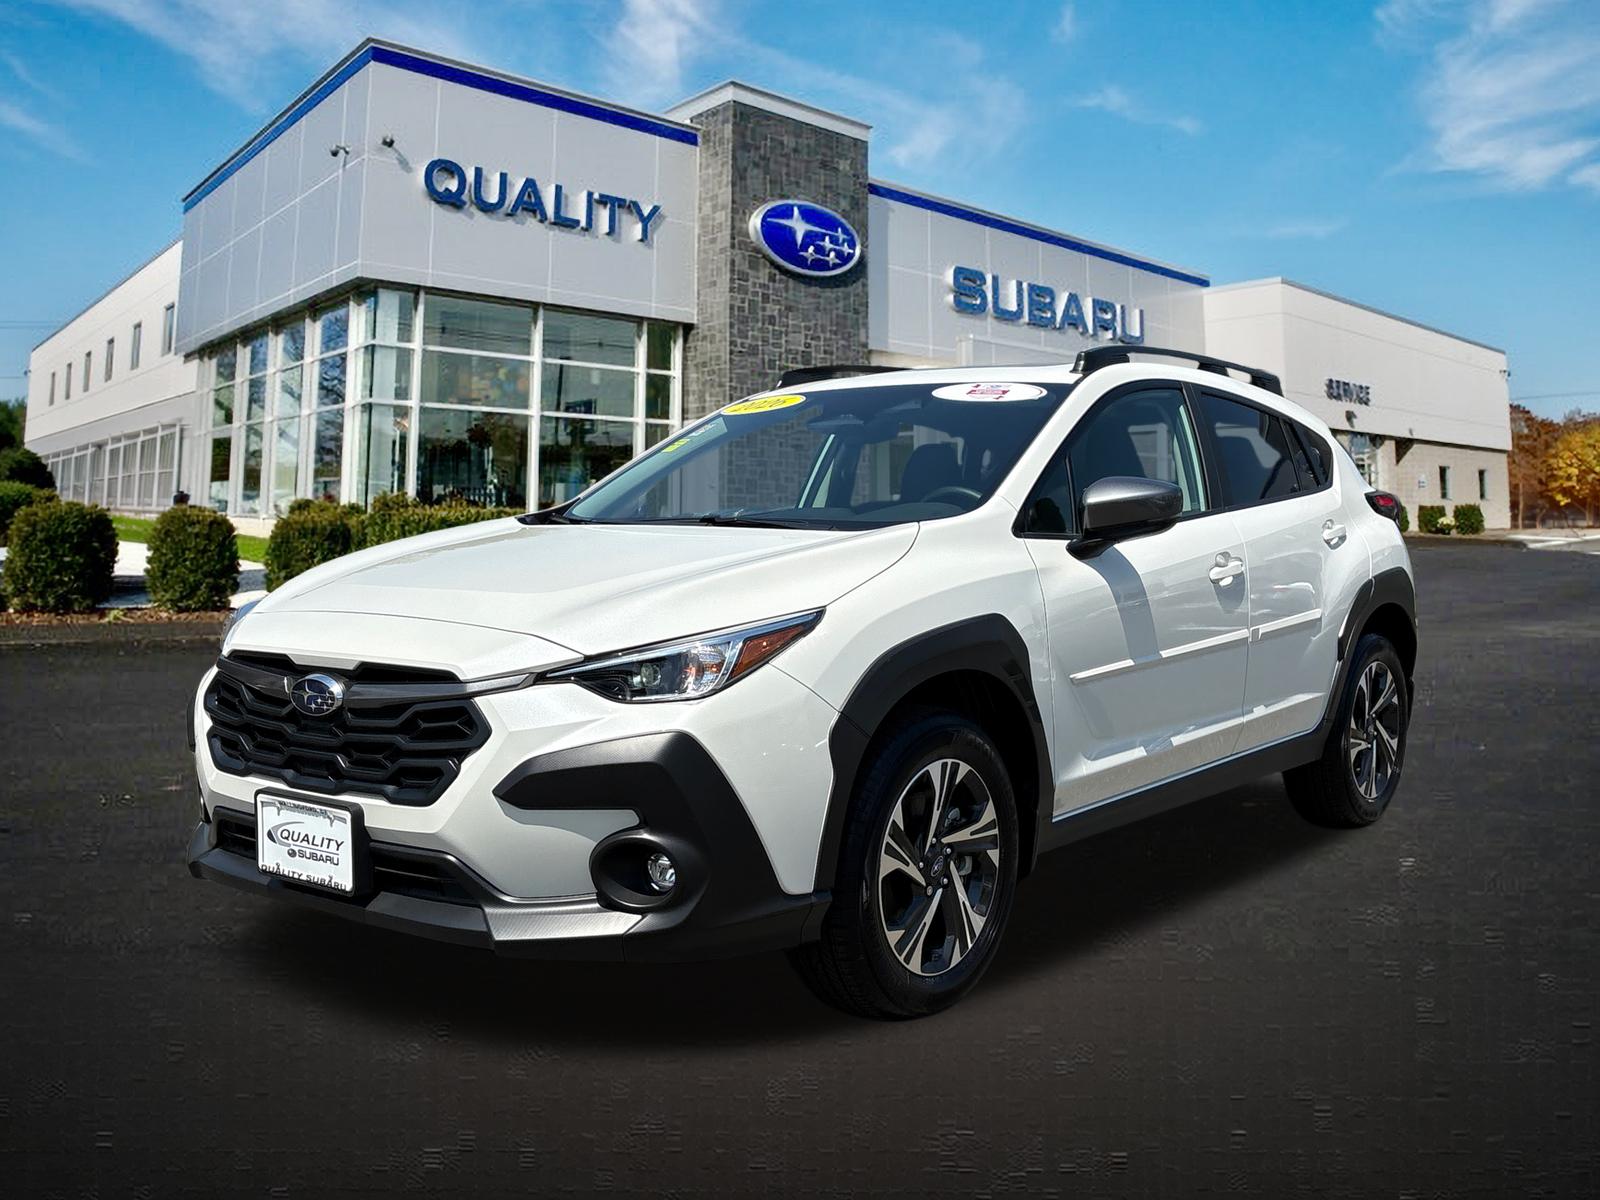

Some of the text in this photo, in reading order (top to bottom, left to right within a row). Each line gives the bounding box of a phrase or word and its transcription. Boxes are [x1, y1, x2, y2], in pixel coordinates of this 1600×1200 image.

[424, 158, 661, 243] QUALITY
[951, 265, 1145, 344] SUBARU
[1325, 378, 1371, 406] SERVICE
[280, 828, 344, 852] QUALITY
[298, 849, 340, 866] SUBARU
[261, 863, 347, 891] QUALITY SUBARU
